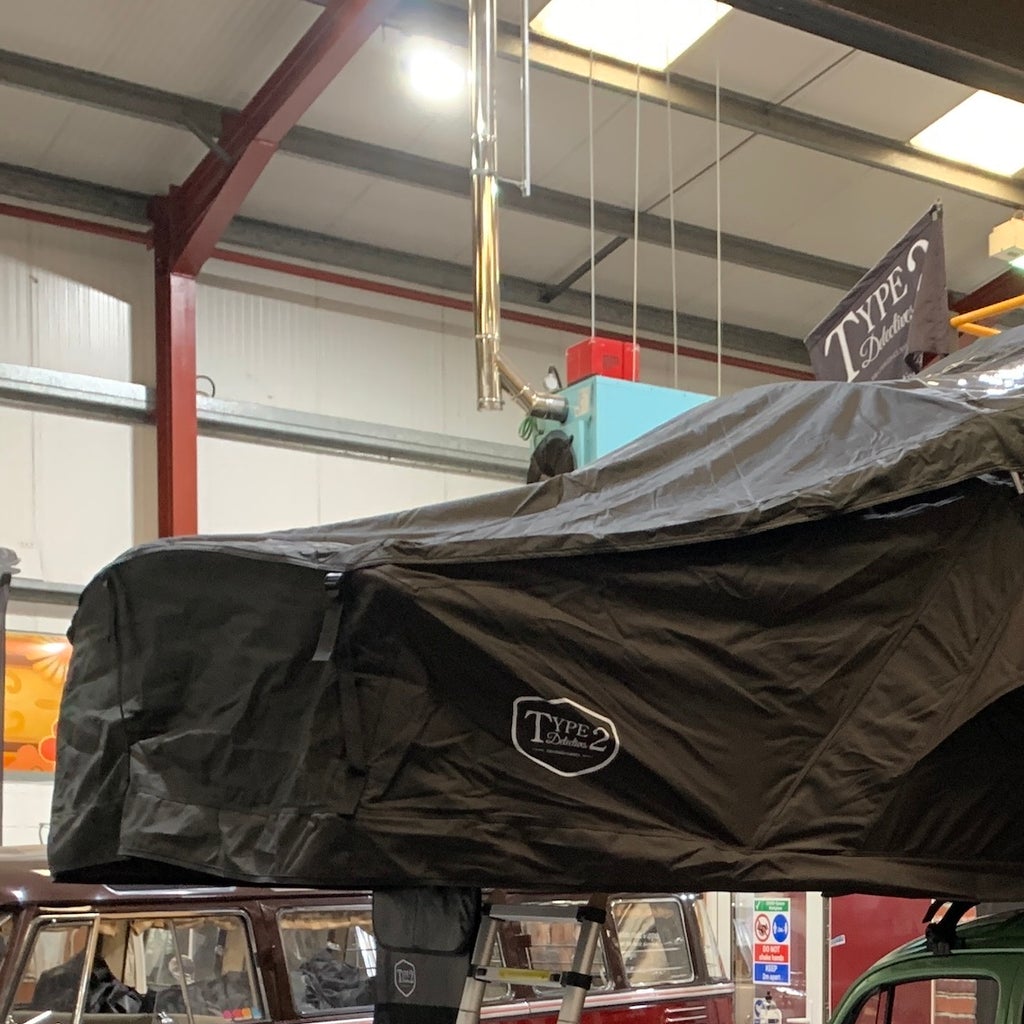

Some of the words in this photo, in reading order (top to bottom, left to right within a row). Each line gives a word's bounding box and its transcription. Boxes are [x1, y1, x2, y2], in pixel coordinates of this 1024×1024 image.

[824, 266, 908, 383] TYPE
[524, 709, 590, 744] TYPE
[589, 727, 610, 752] 2
